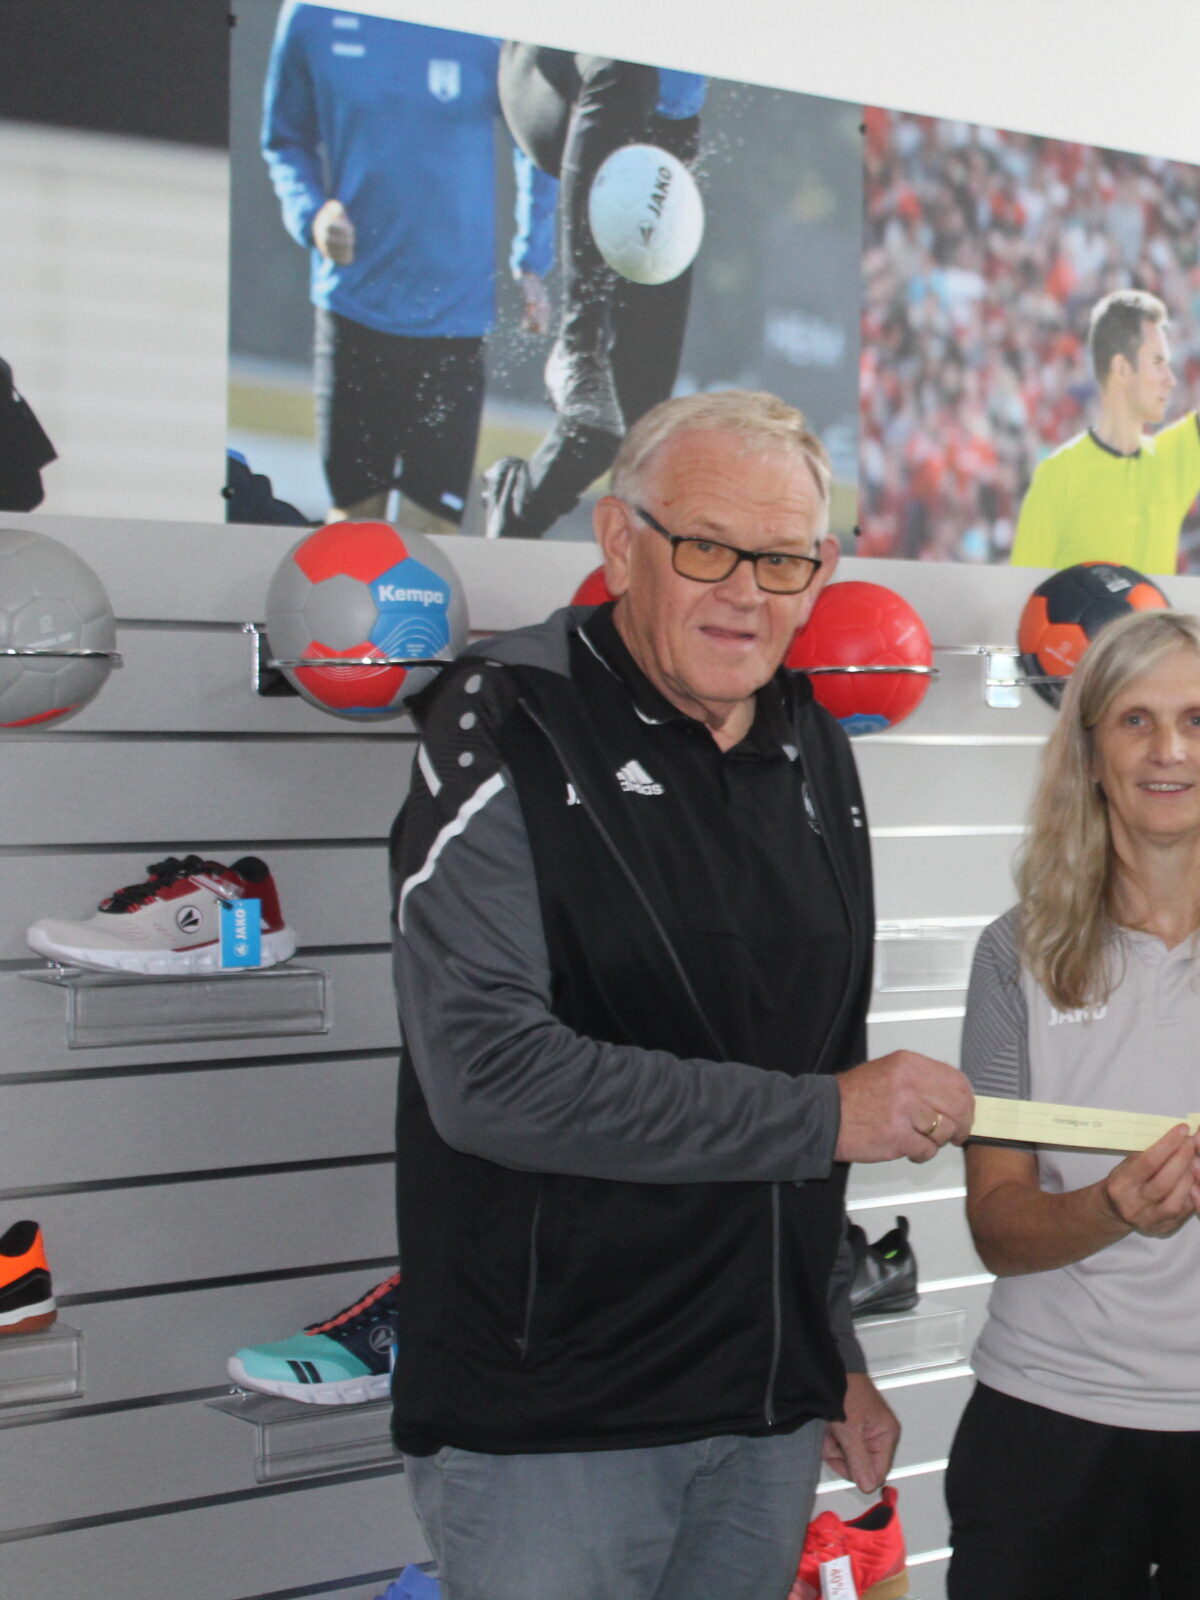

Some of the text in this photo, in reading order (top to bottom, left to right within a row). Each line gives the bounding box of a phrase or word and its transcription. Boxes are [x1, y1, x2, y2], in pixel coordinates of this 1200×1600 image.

[647, 166, 672, 219] JAKO
[377, 584, 445, 607] Kempa
[235, 908, 247, 941] JAKO
